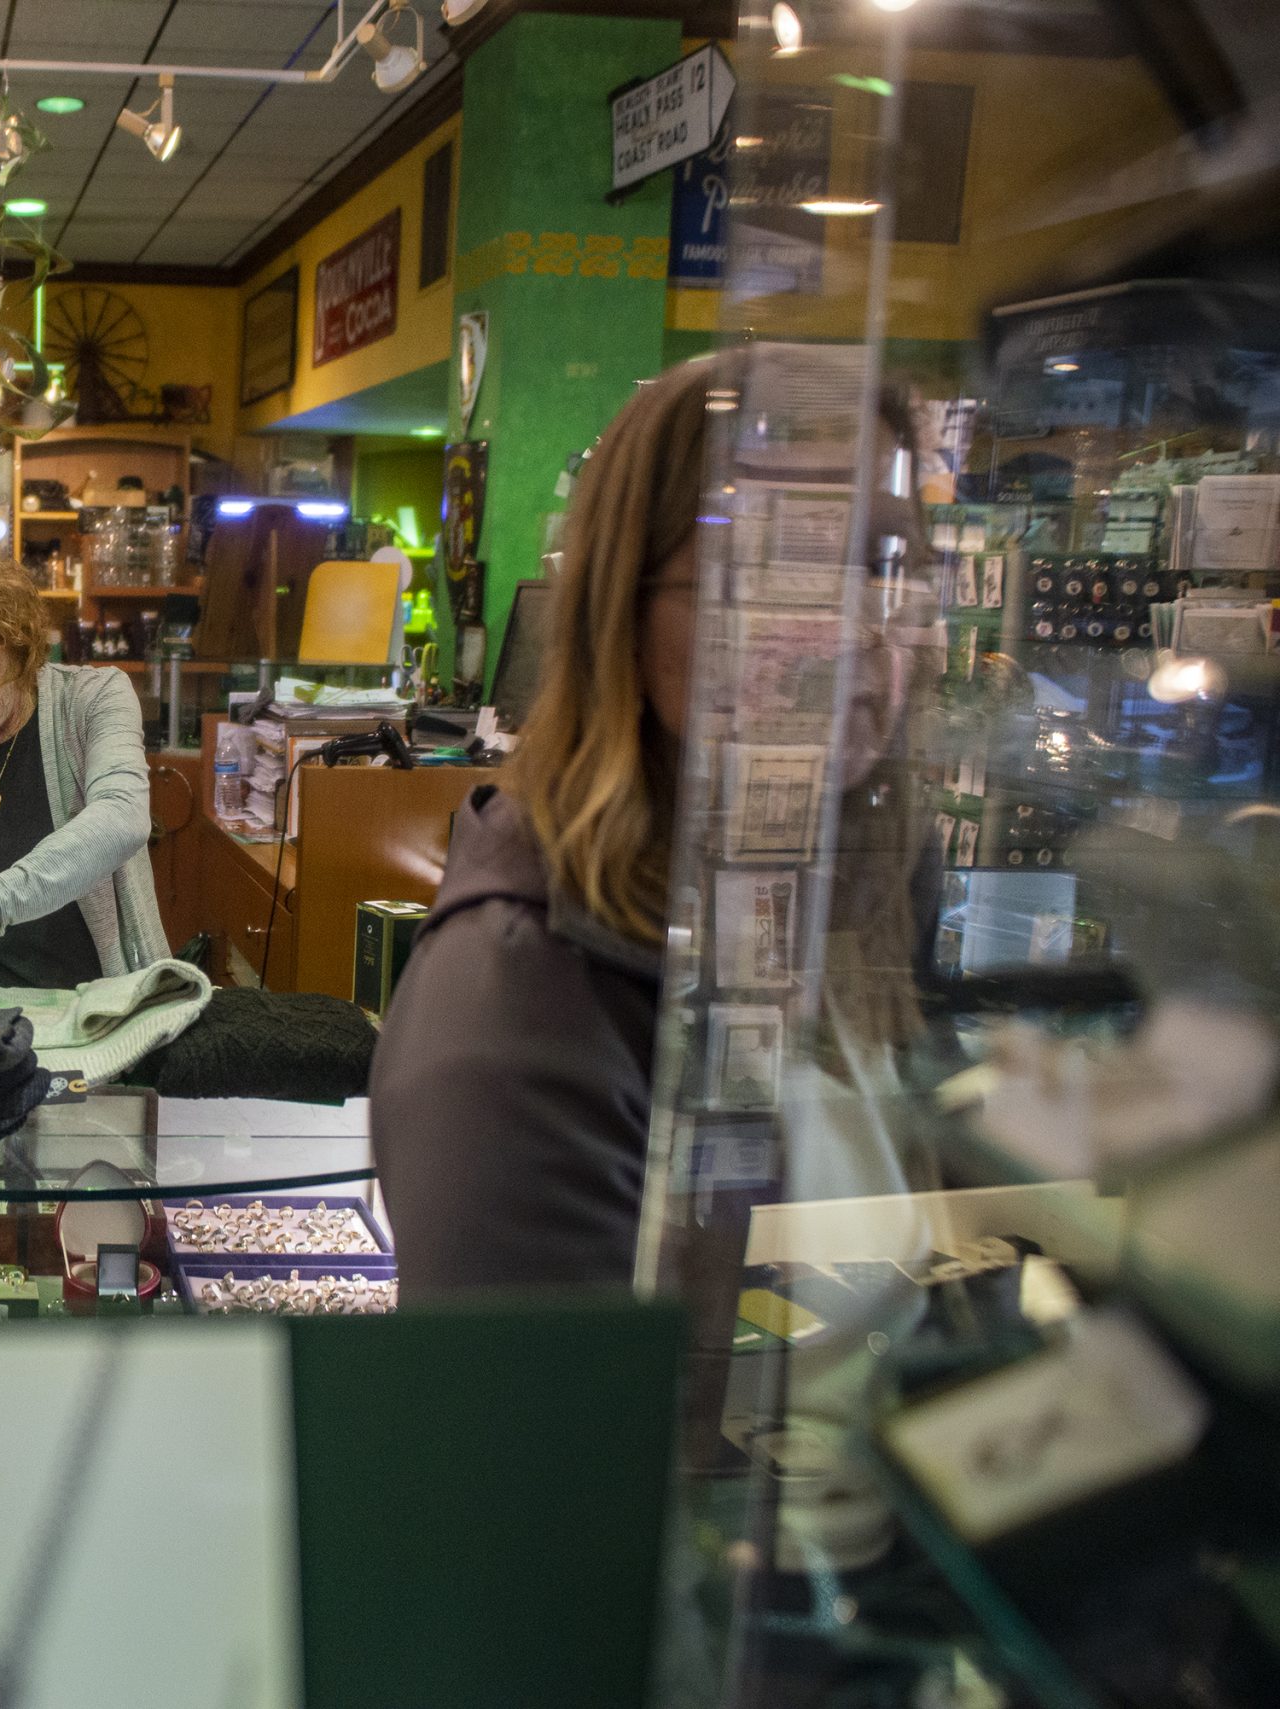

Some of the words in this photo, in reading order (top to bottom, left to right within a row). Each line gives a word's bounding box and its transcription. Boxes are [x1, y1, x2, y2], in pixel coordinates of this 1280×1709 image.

[690, 62, 705, 95] 12
[616, 105, 650, 137] HEALY
[656, 89, 683, 118] PASS
[617, 137, 652, 172] COAST
[657, 120, 688, 153] ROAD
[346, 288, 392, 344] COCOA
